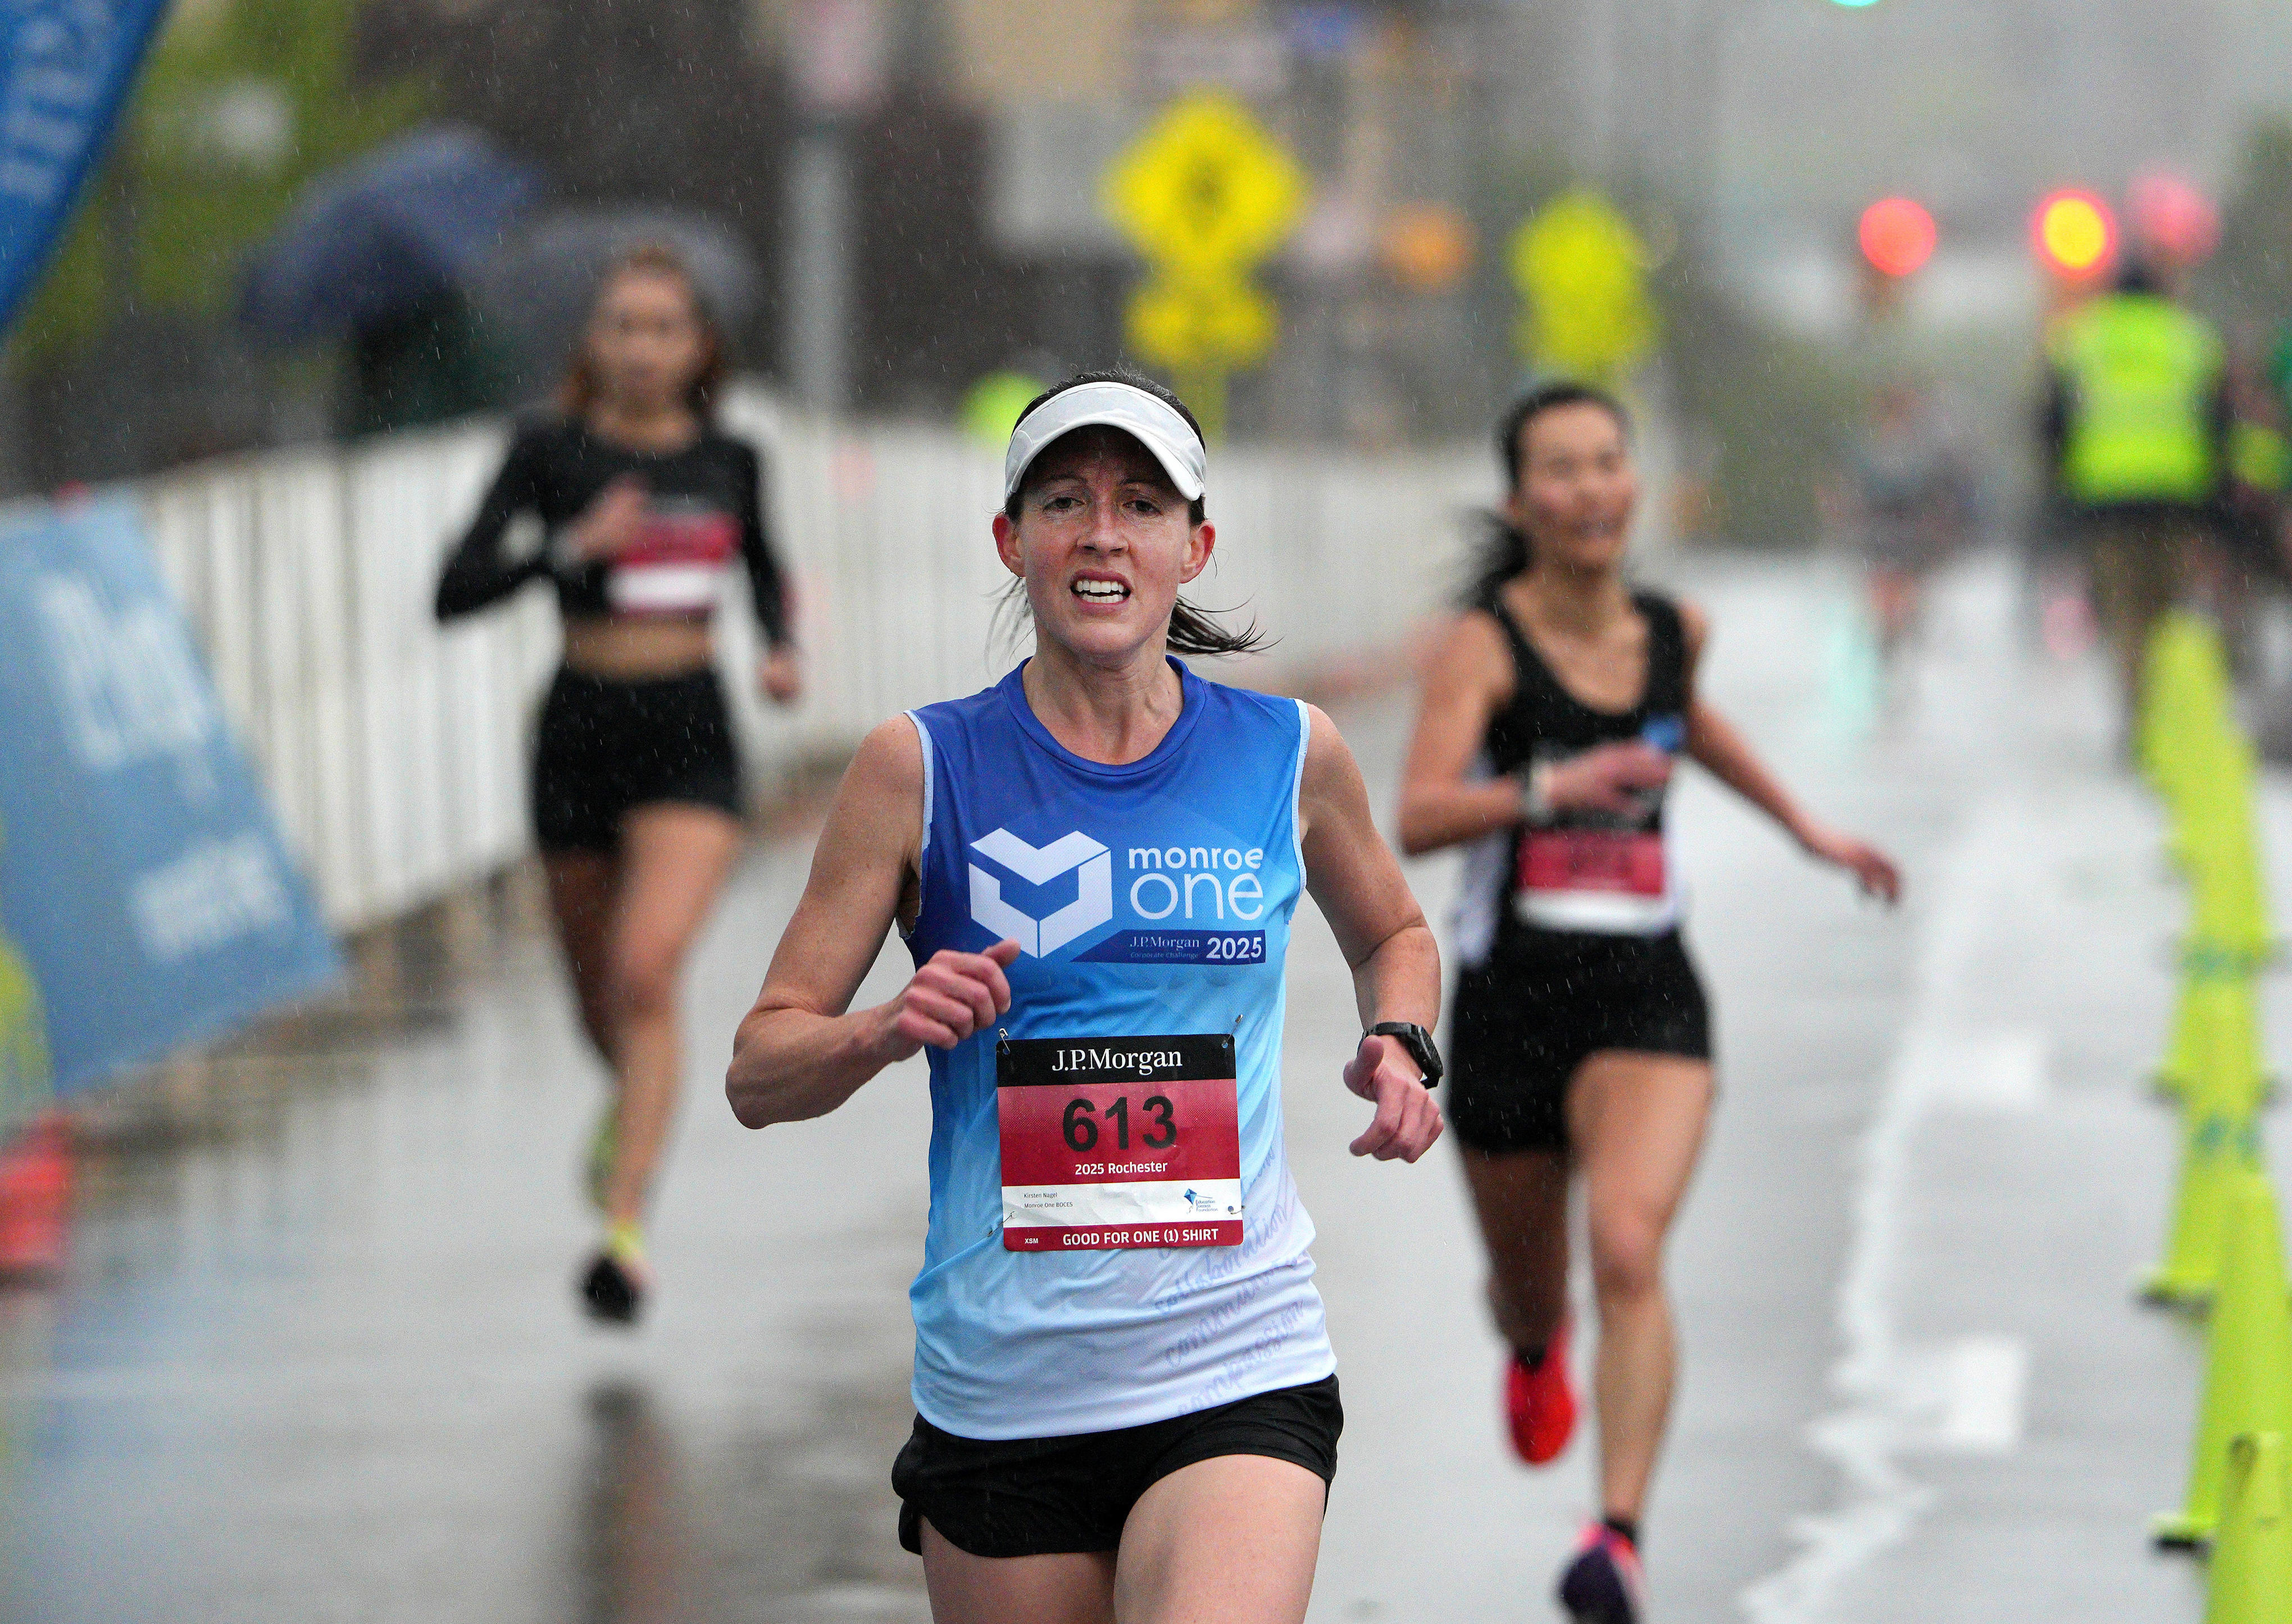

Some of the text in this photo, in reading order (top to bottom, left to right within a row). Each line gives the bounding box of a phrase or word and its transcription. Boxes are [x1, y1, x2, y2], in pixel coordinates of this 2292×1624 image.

[1128, 847, 1264, 870] monroe
[1130, 872, 1264, 921] one
[1206, 936, 1262, 959] 2025
[1052, 1048, 1183, 1076] J.P.Morgan
[1062, 1095, 1178, 1153] 613
[1075, 1161, 1168, 1176] 2025 Rochester
[1062, 1228, 1219, 1246] GOOD FOR ONE (1) SHIRT
